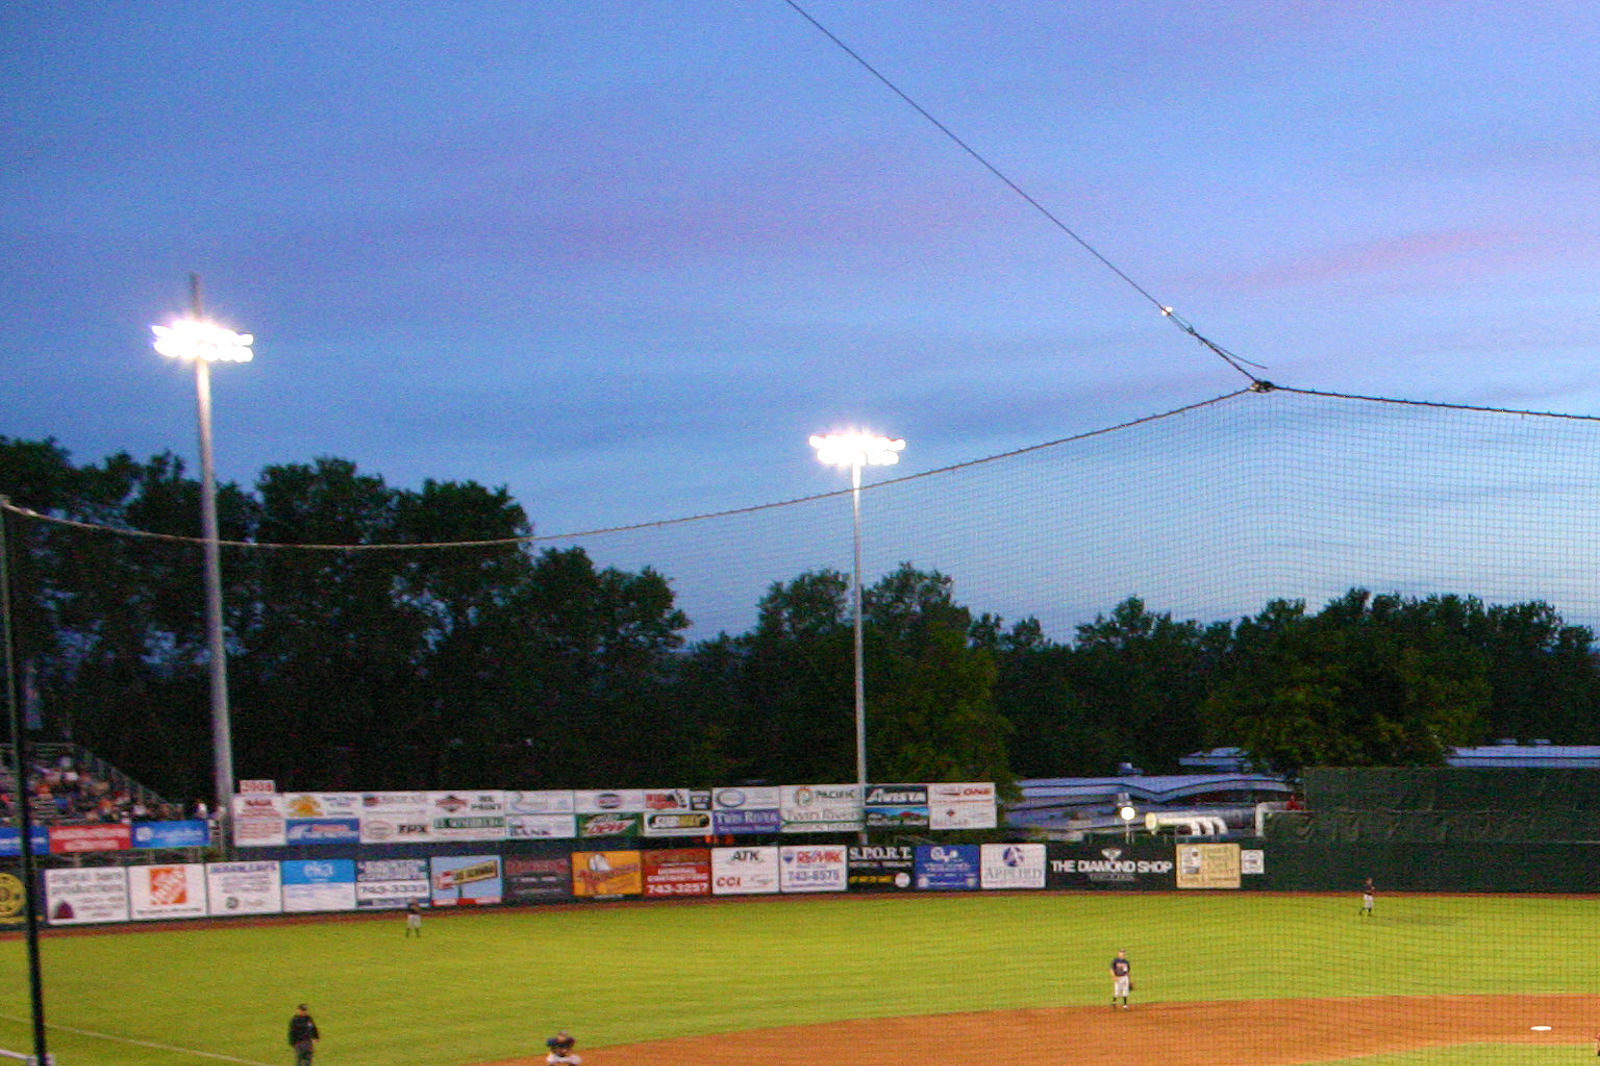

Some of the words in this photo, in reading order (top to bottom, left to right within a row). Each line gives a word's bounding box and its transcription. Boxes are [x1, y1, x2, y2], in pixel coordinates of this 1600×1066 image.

[1050, 860, 1076, 873] THE
[1077, 860, 1137, 873] DIAMOND
[1137, 861, 1173, 873] SHOP
